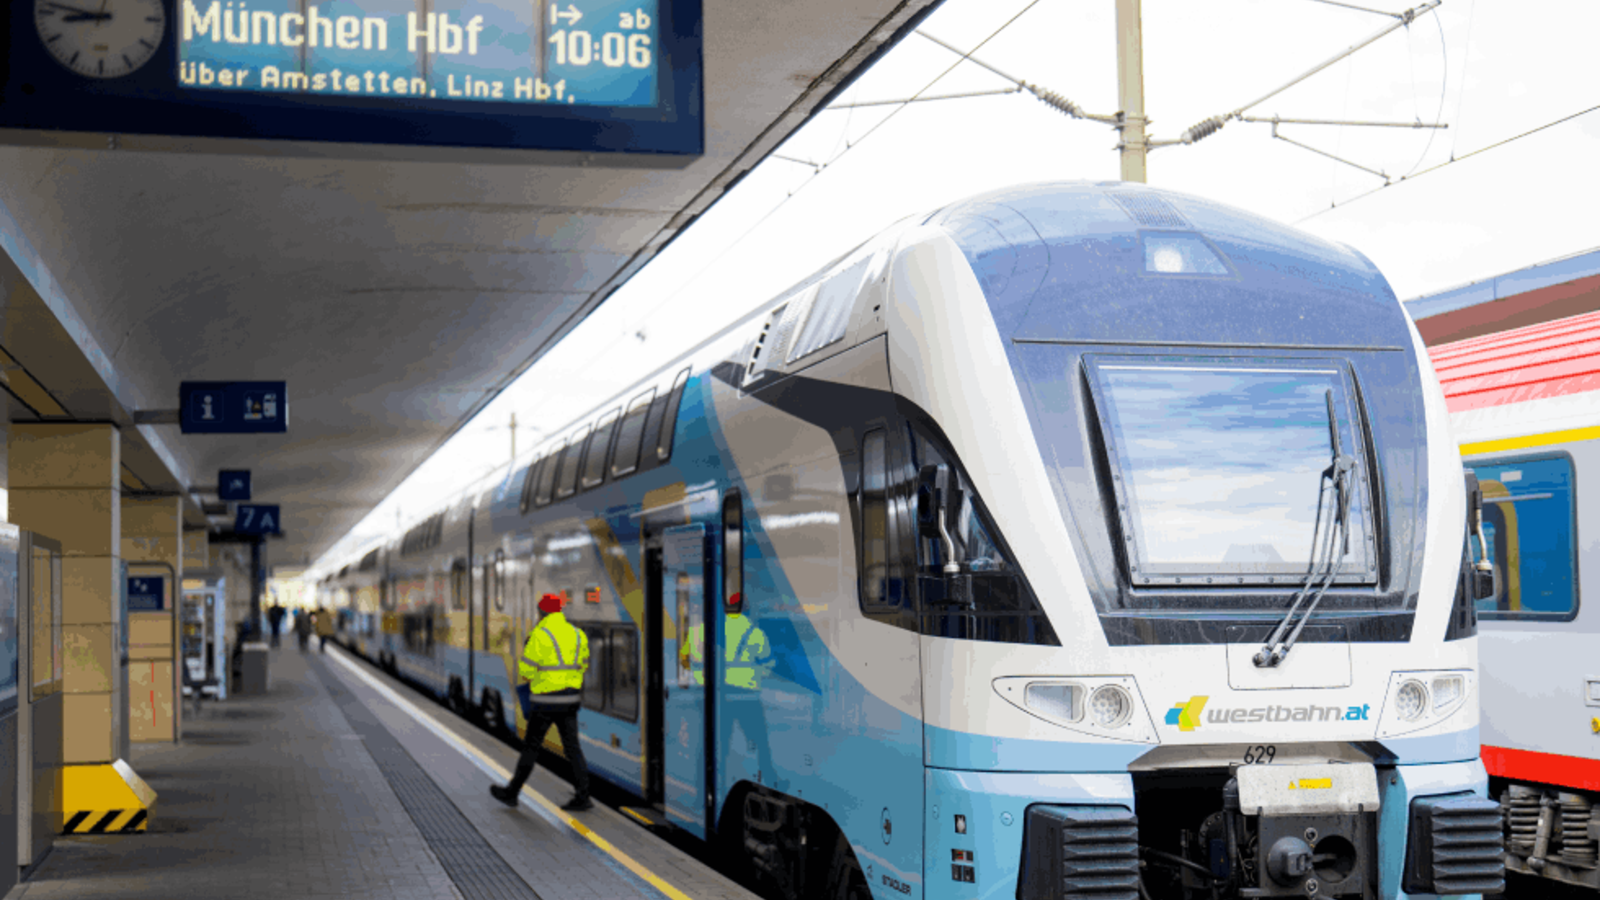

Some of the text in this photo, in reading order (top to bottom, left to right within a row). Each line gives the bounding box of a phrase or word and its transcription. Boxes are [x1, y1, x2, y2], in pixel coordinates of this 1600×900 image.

[183, 0, 484, 55] München Hbf
[619, 8, 651, 29] ab
[548, 29, 651, 68] 10:06
[180, 61, 575, 104] über Amstetten, Linz Hbf,
[242, 507, 275, 529] 7 A
[1207, 703, 1371, 724] westbahn.at
[1243, 745, 1276, 765] 629
